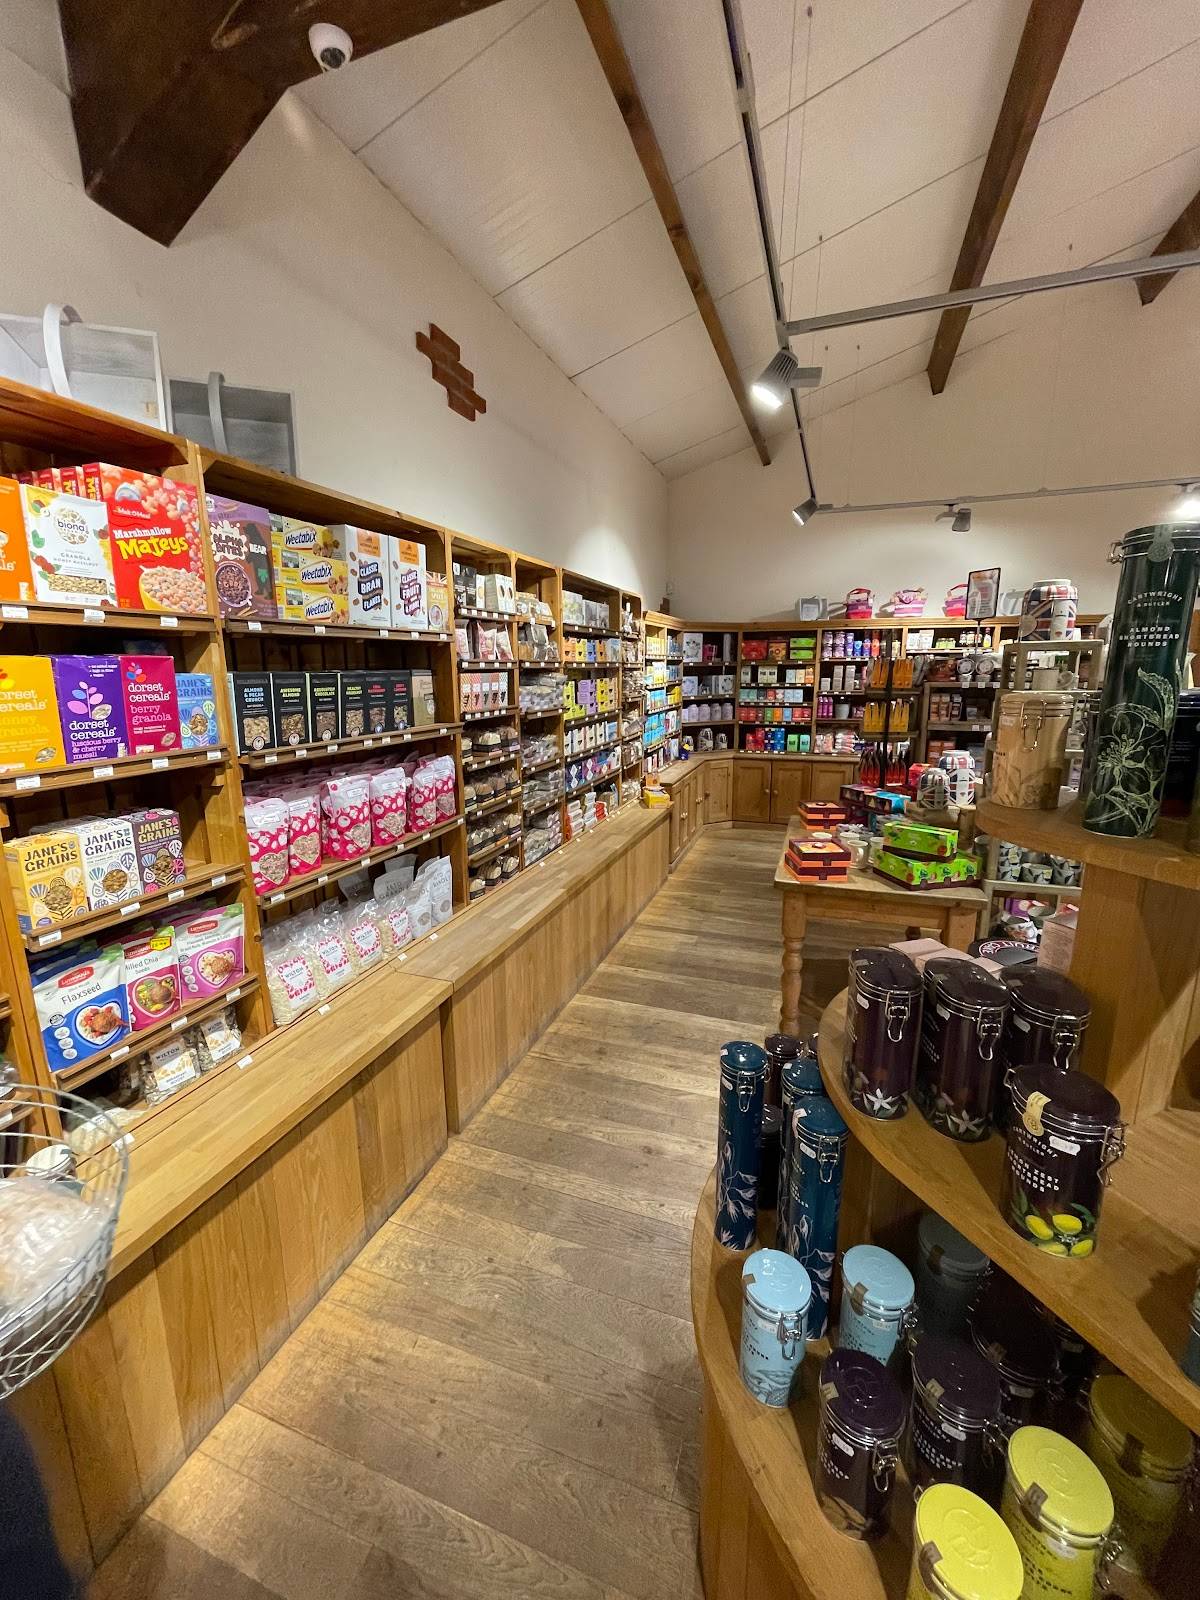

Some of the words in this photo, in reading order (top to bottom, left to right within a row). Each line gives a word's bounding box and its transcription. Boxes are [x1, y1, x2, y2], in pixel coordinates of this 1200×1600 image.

[57, 519, 85, 532] biona
[113, 527, 172, 539] Marshmallow
[285, 530, 317, 545] Weetabix
[301, 564, 333, 581] Weetabix
[360, 563, 378, 577] CLASSIC
[360, 577, 381, 594] BRAN
[305, 600, 335, 617] Weetabix
[128, 682, 164, 693] dorset
[129, 691, 170, 703] cereals
[130, 704, 161, 714] berry
[69, 719, 110, 731] dorset
[132, 713, 172, 726] granola
[70, 727, 116, 741] cereals
[138, 818, 172, 834] JANE'S
[84, 829, 123, 847] JANE'S
[138, 825, 180, 844] GRAINS
[24, 842, 68, 862] JANE'S
[85, 836, 132, 857] GRAINS
[25, 850, 78, 872] GRAINS
[321, 945, 338, 955] WILTON
[144, 956, 159, 966] Chia
[285, 966, 304, 978] WILTON
[61, 982, 101, 1005] Flaxseed
[155, 1046, 180, 1060] WILTON
[1033, 1168, 1059, 1184] ZEST
